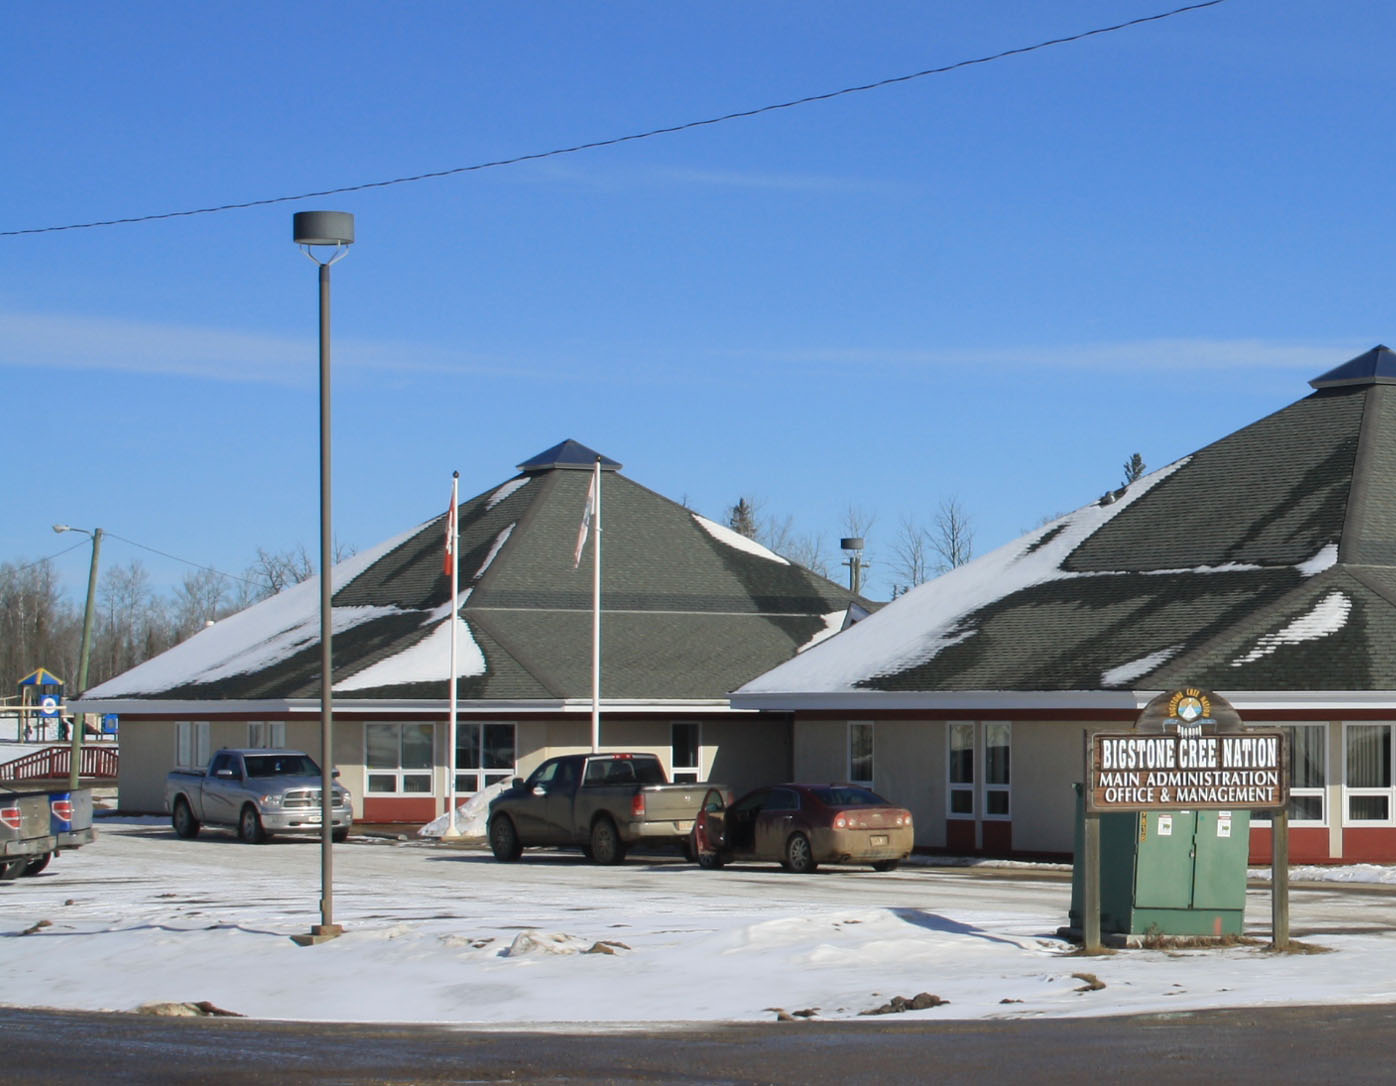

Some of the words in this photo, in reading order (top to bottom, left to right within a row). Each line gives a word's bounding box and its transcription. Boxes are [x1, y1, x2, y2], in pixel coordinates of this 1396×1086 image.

[1103, 739, 1175, 769] BIGSTONE
[1179, 739, 1217, 768] CREE
[1223, 738, 1277, 767] NATION
[1099, 772, 1140, 787] MAIN
[1147, 771, 1278, 786] ADMINISTRATION
[1105, 788, 1154, 803] OFFICE
[1160, 788, 1170, 803] &
[1176, 787, 1275, 802] MANAGEMENT
